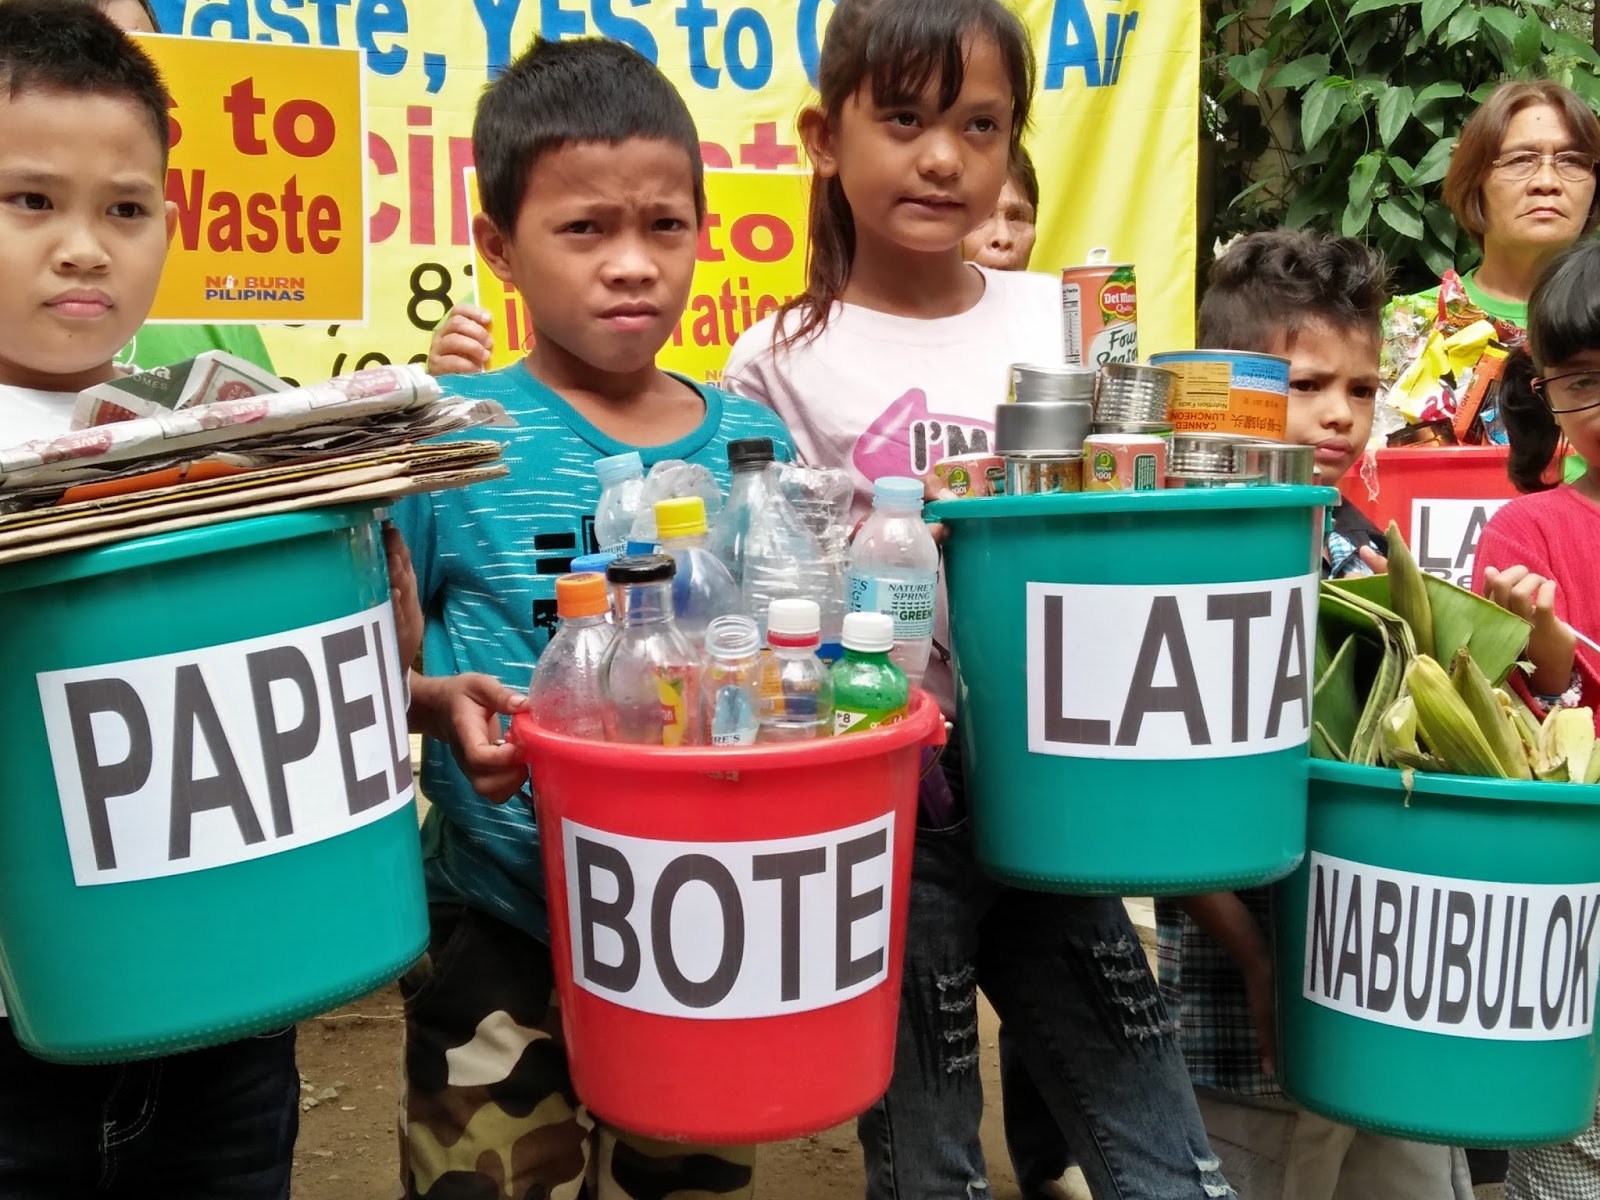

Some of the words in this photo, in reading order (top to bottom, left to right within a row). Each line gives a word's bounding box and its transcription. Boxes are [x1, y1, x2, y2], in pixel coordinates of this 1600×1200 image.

[675, 0, 773, 90] to
[1044, 0, 1139, 90] Air
[223, 76, 336, 158] to
[244, 276, 305, 289] BURN
[205, 289, 305, 302] PILIPINAS
[1104, 293, 1120, 304] Del
[1120, 293, 1136, 303] Mon
[131, 375, 168, 390] OMES
[1198, 401, 1228, 409] Nutrition
[1170, 412, 1225, 421] LUNCHEON
[1175, 422, 1217, 431] CANNED
[72, 433, 108, 449] SAVE
[1419, 506, 1503, 569] LA
[888, 583, 934, 592] NATURE'S
[893, 593, 931, 601] SPRING
[1044, 587, 1309, 746] LATA
[64, 621, 412, 871] PAPEL
[575, 827, 888, 1008] BOTE
[1310, 864, 1600, 1031] NABUBULOK
